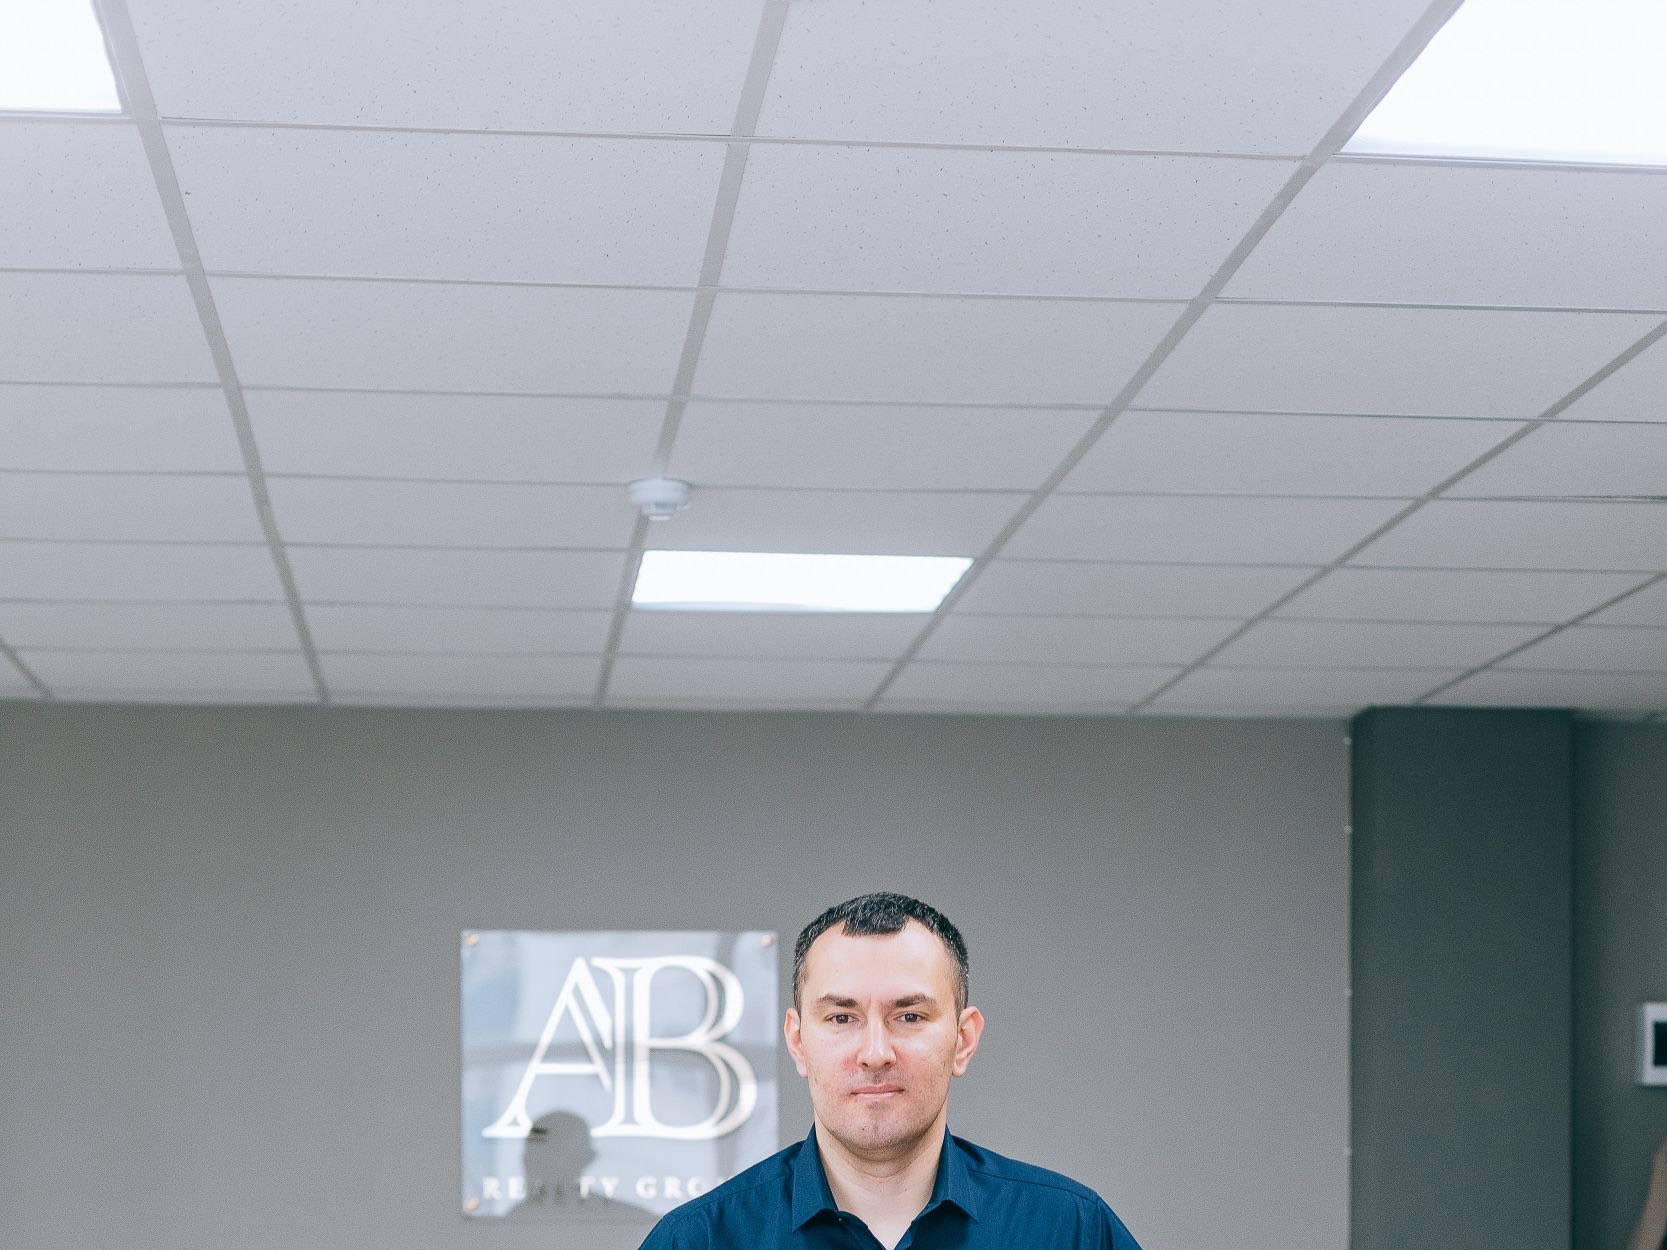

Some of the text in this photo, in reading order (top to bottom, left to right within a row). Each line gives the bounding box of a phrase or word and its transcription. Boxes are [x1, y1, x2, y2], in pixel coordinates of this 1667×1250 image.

[481, 955, 758, 1140] AB
[482, 1175, 727, 1201] RETY GRO
